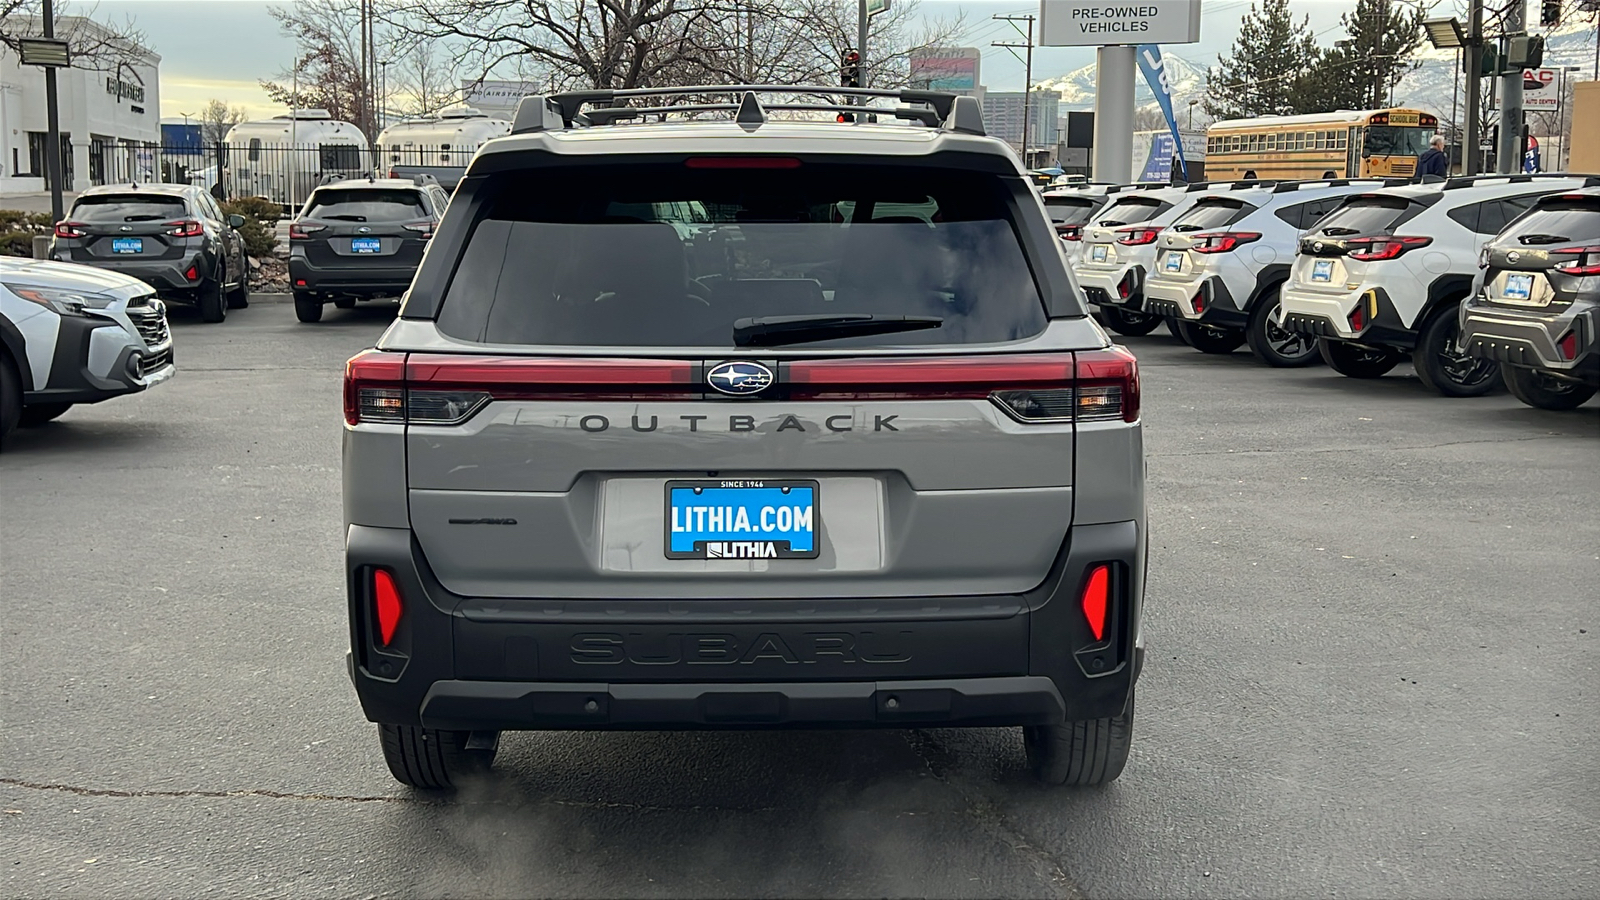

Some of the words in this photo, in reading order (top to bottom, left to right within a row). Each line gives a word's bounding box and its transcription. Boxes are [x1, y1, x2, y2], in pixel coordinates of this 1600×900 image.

[1072, 6, 1158, 19] PRE-OWNED
[1080, 21, 1149, 33] VEHICLES
[1390, 115, 1408, 123] SCHOOL
[1409, 116, 1418, 124] BUS
[580, 415, 899, 432] OUTBACK
[672, 506, 813, 533] LITHIA.COM
[722, 542, 778, 558] LITHIA
[570, 632, 913, 665] SUBARU
